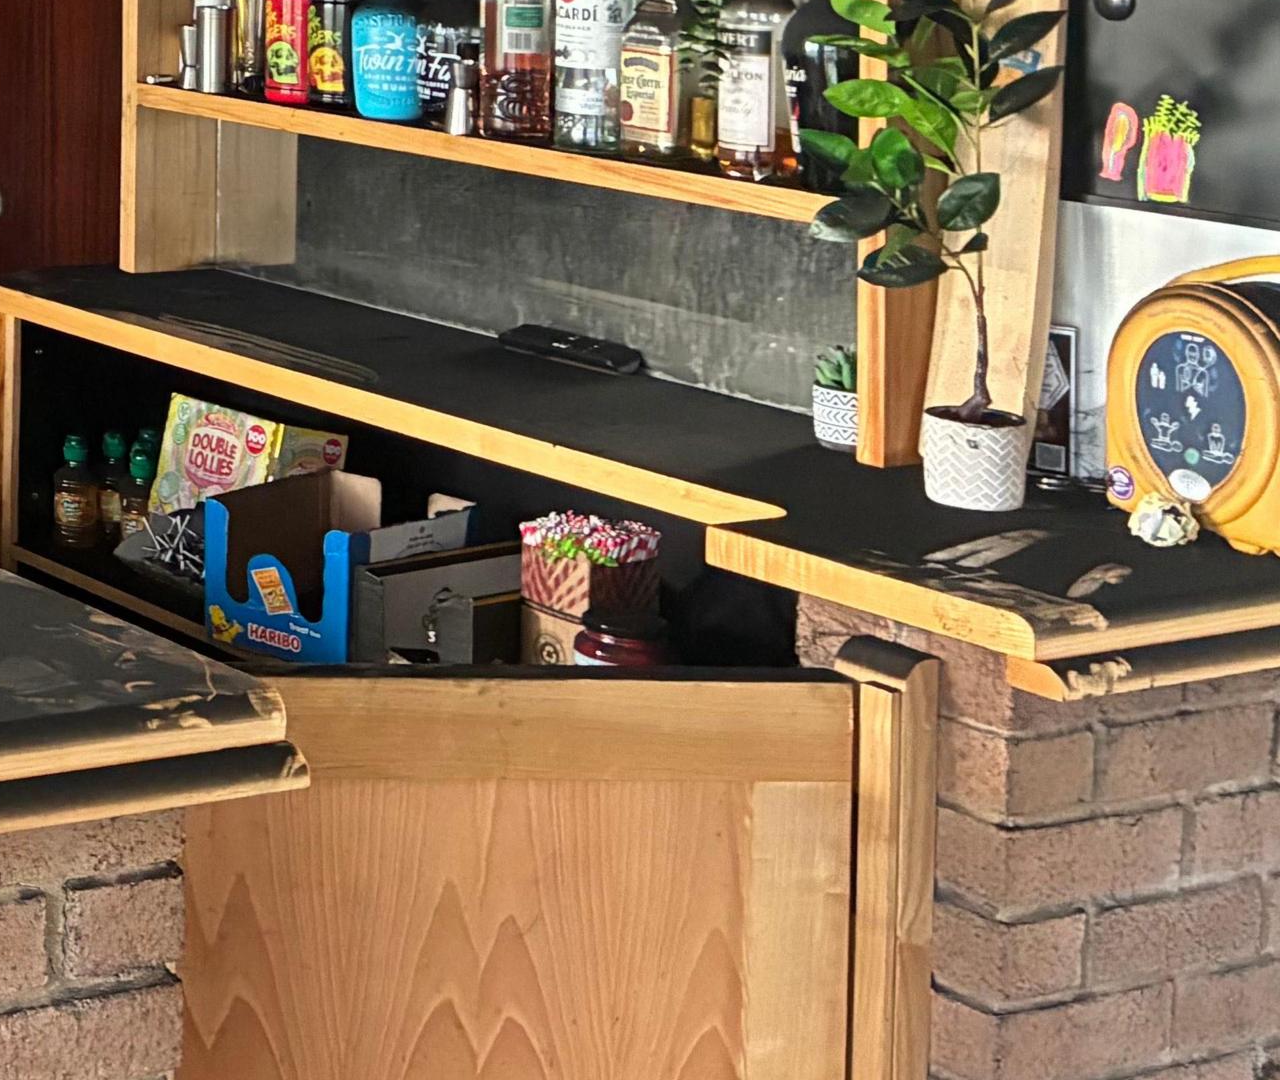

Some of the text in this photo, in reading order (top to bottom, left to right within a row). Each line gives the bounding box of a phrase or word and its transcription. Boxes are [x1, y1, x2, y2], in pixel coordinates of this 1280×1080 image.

[557, 4, 599, 22] CARDÍ
[192, 432, 238, 460] DOUBLE
[247, 430, 266, 445] 100
[189, 449, 234, 477] LOLLIES
[248, 623, 301, 652] HARIBO
